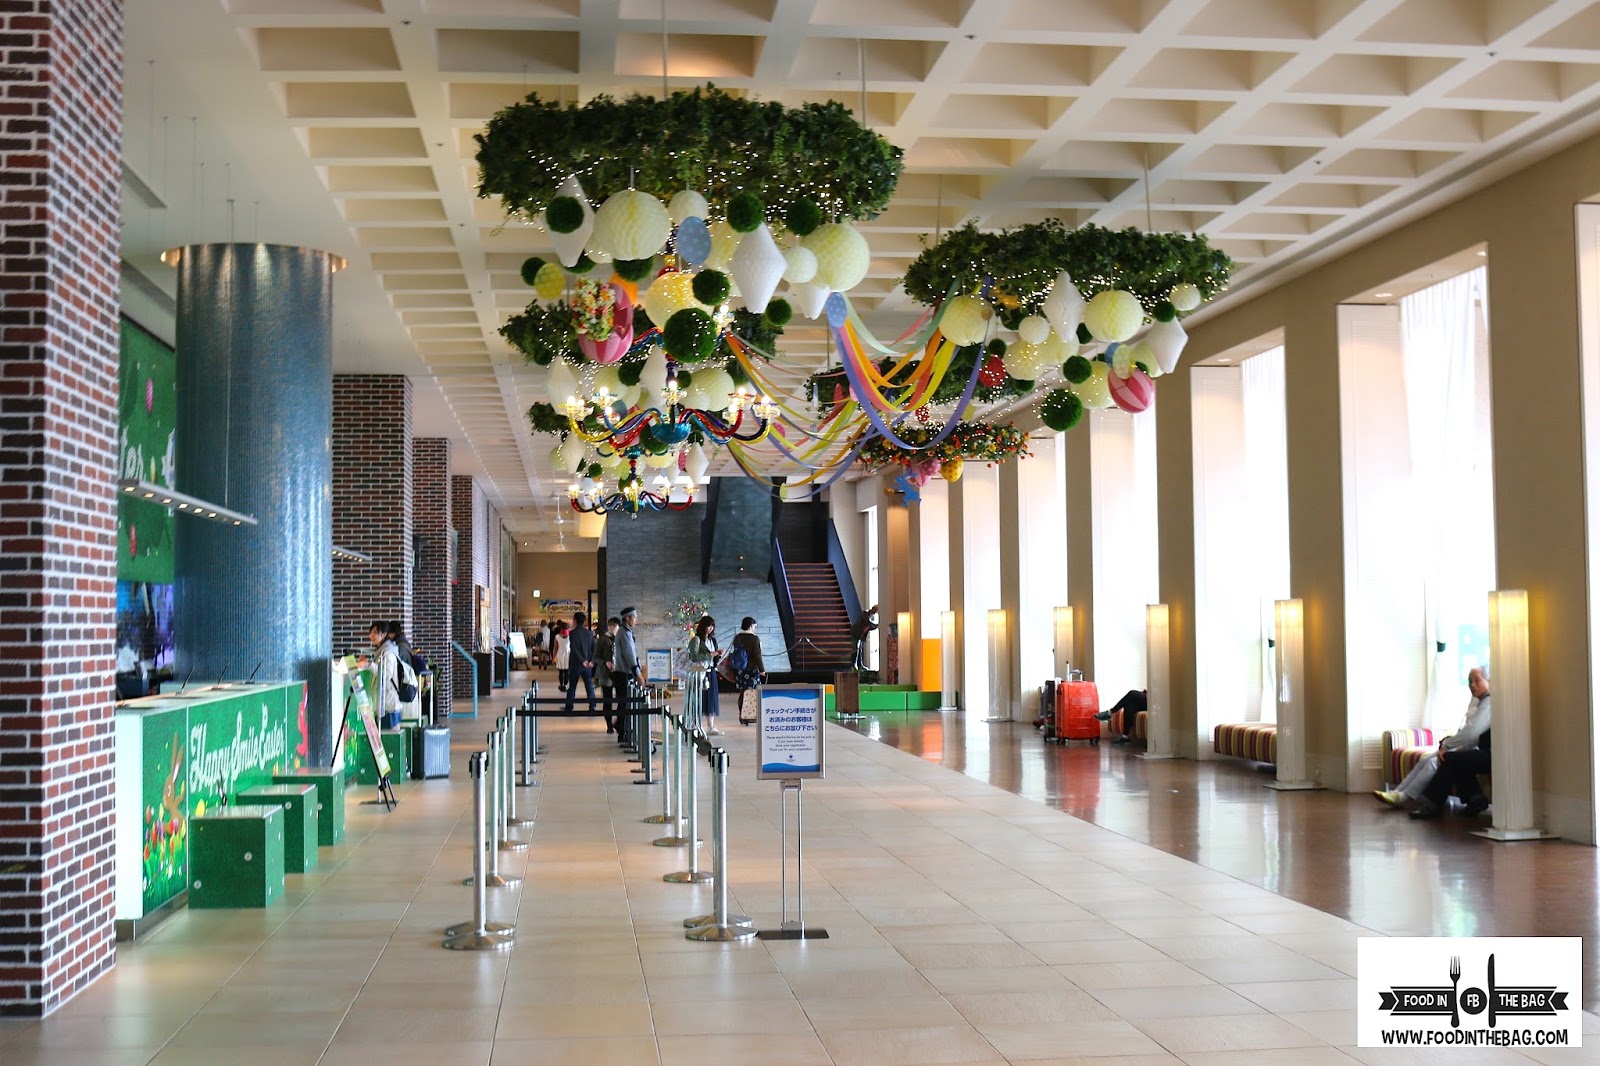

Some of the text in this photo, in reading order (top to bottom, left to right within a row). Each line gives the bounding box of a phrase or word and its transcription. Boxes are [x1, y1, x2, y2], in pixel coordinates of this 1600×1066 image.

[190, 722, 231, 797] Happy
[230, 710, 258, 789] Smile
[259, 703, 285, 771] Easter
